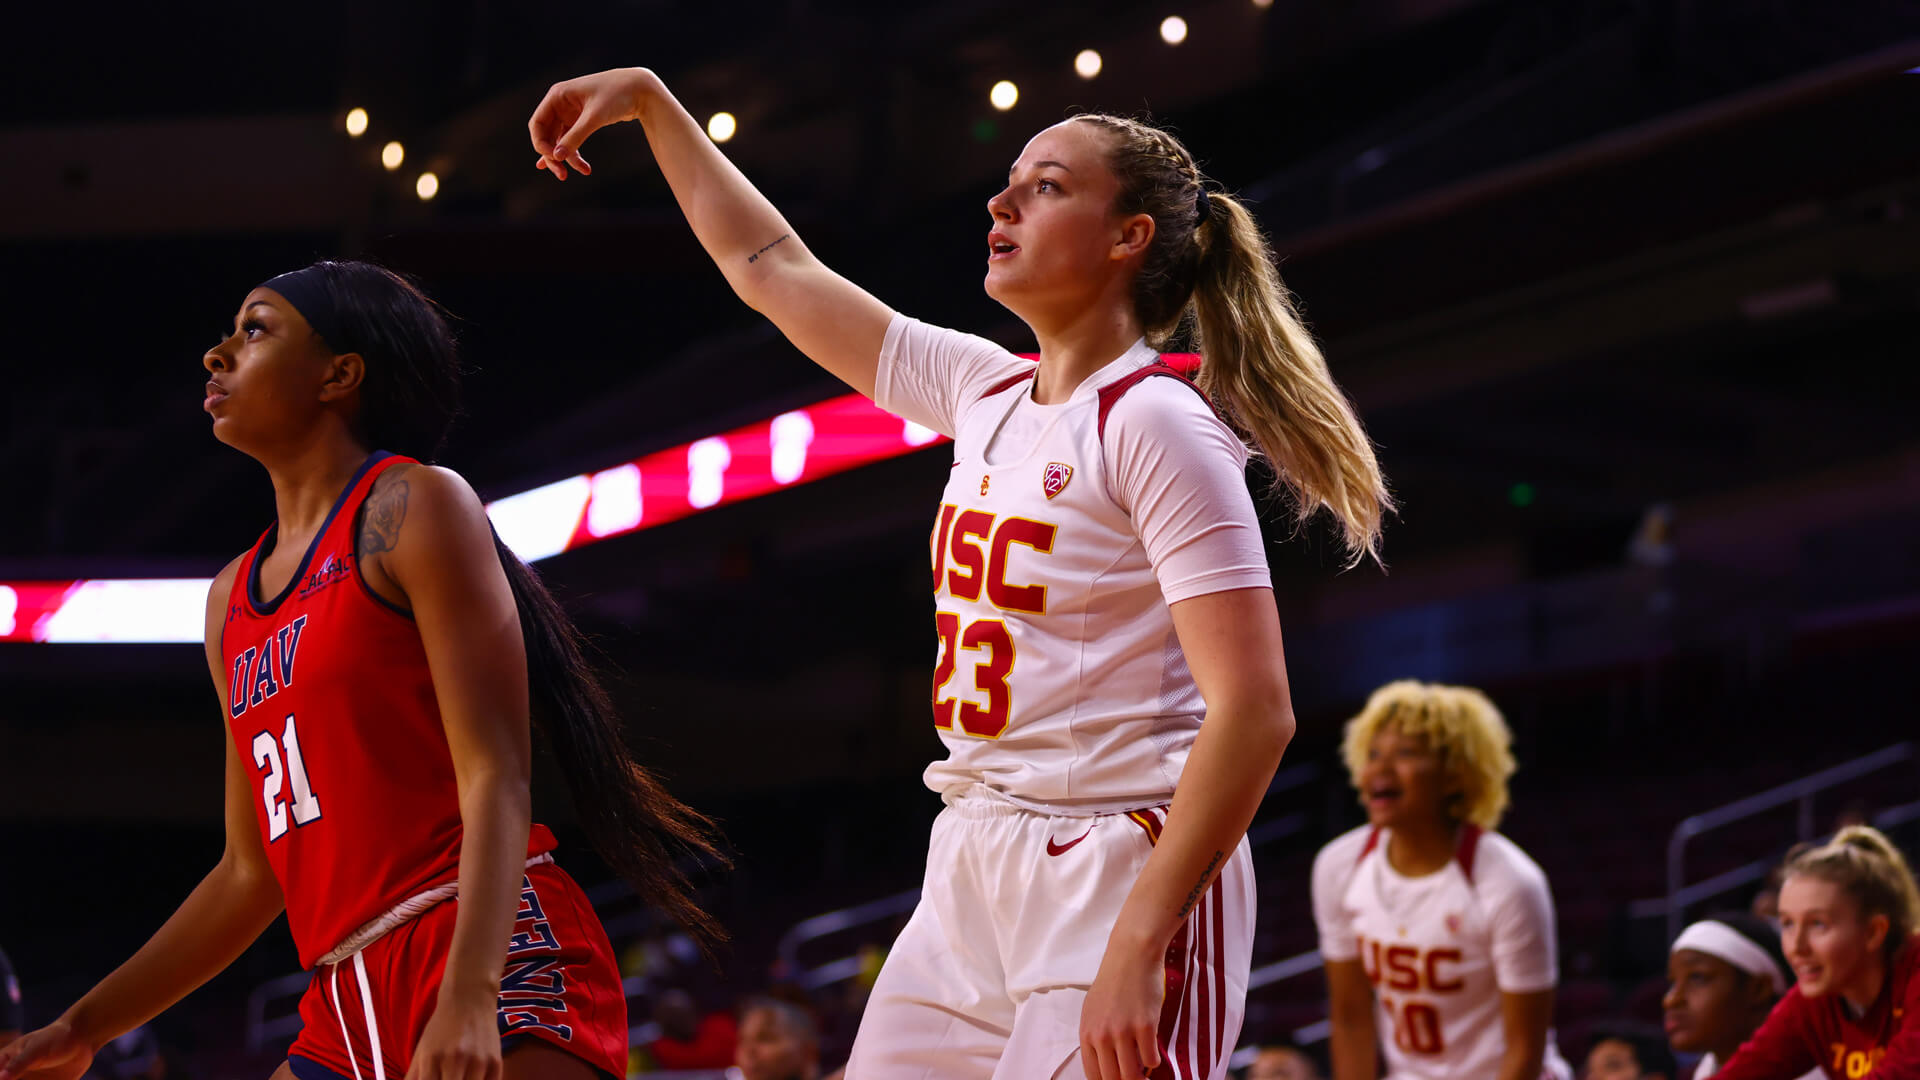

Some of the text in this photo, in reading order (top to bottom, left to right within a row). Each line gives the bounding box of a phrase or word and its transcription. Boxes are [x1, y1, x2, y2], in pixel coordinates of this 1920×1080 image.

[1044, 463, 1071, 487] PAC
[1045, 477, 1060, 492] 12
[930, 503, 1058, 616] USC
[231, 614, 308, 719] UAV
[933, 611, 1016, 740] 23
[252, 712, 323, 845] 21
[1357, 935, 1464, 993] USC
